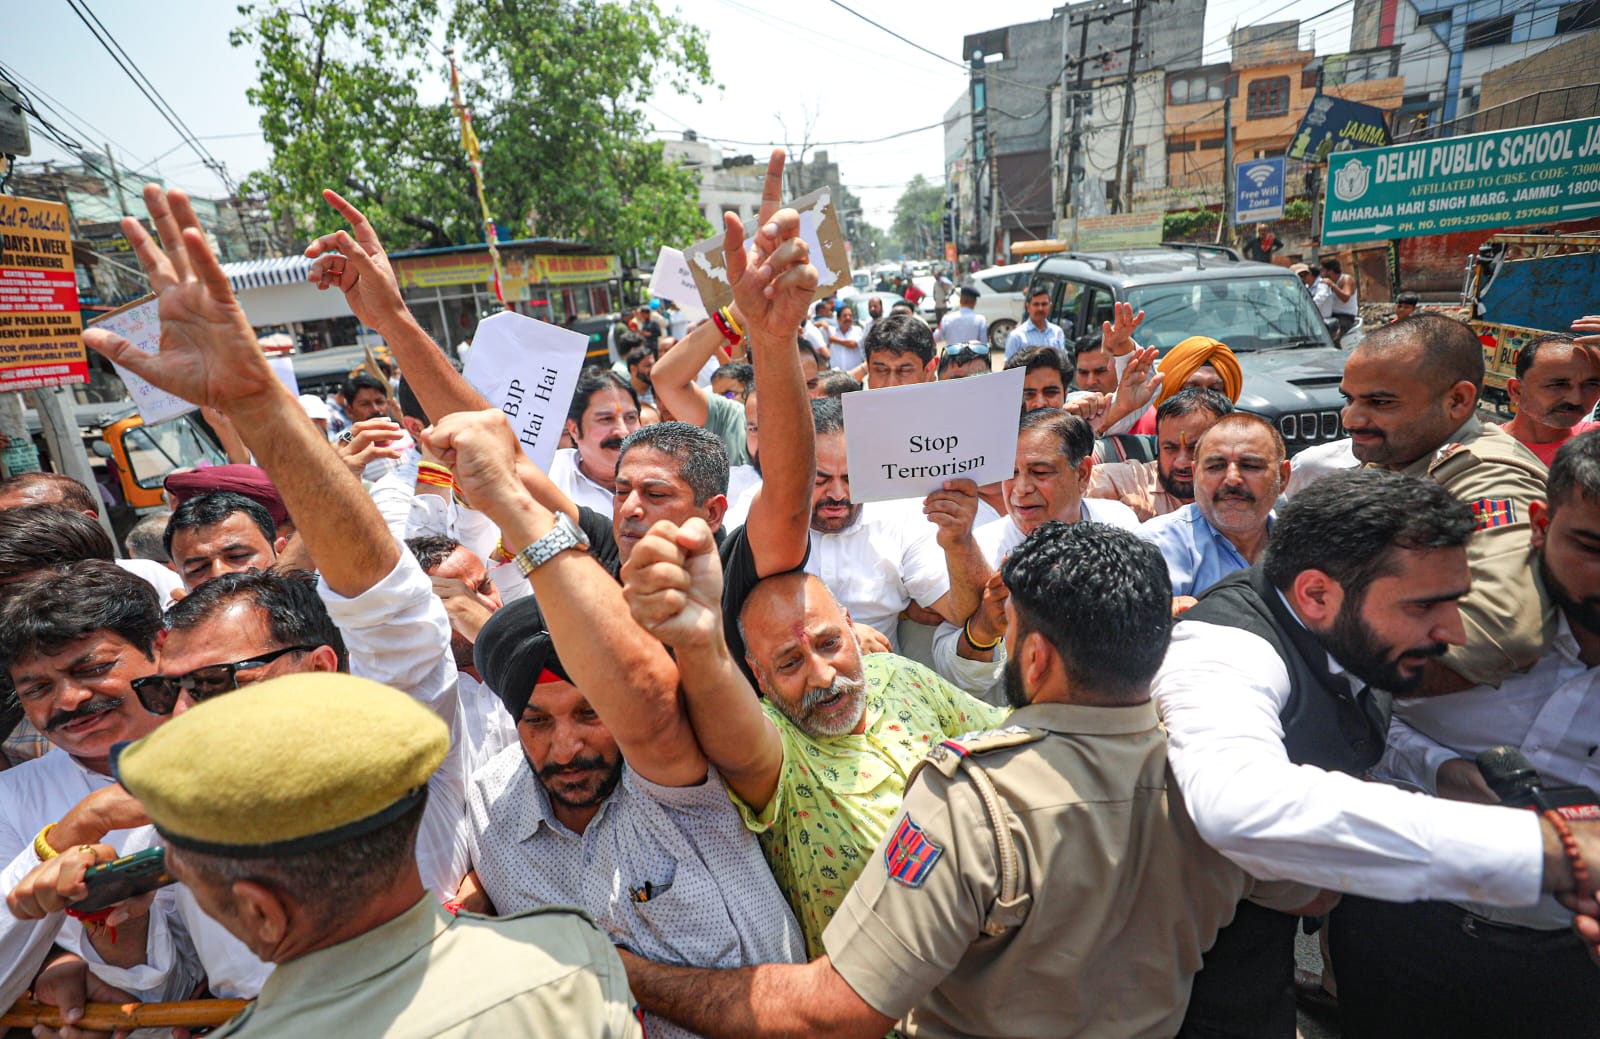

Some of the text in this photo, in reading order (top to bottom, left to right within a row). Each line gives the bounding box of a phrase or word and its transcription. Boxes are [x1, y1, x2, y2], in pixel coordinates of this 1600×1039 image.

[1375, 149, 1426, 184] DELHI
[1428, 139, 1495, 177] PUBLIC
[1498, 129, 1573, 168] SCHOOL
[1409, 178, 1475, 196] AFFILIATED
[1479, 175, 1493, 189] TO
[1530, 166, 1568, 181] CODE-
[1240, 184, 1279, 201] Free Wifi
[1331, 179, 1600, 223] MAHARAJA HARI SINGH MARG. JAMMU- 1800
[1248, 198, 1270, 209] Zone
[1397, 221, 1415, 232] PH.
[1418, 219, 1436, 230] NO.
[4, 235, 31, 252] DAYS
[33, 238, 40, 252] A
[15, 255, 64, 268] CONVENIENCE
[15, 316, 45, 325] PALIKA
[53, 328, 80, 336] JAMMU
[502, 378, 526, 419] BJP
[519, 366, 558, 449] Hai Hai
[909, 435, 958, 454] Stop
[881, 454, 985, 480] Terrorism
